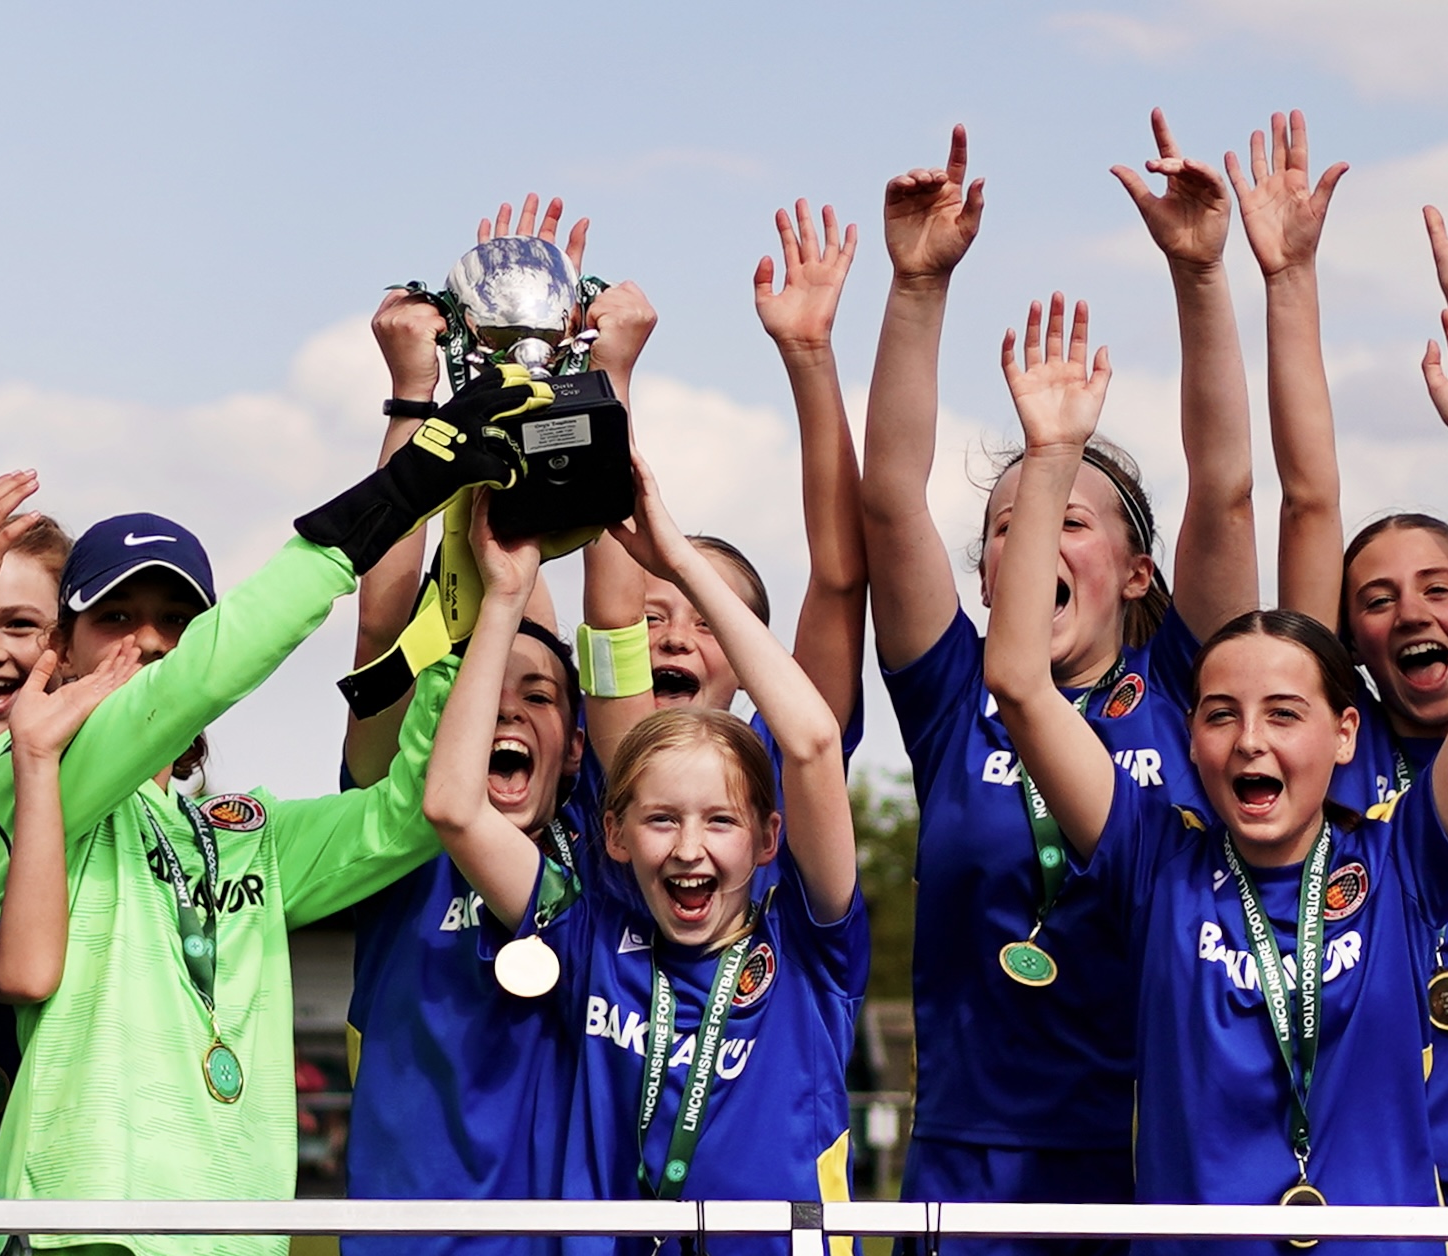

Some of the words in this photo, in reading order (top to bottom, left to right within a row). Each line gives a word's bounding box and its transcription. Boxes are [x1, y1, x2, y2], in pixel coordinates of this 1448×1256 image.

[1237, 874, 1266, 942] FOOTBALL
[1304, 874, 1323, 942] FOOTBALL
[1256, 939, 1290, 1042] LINCOLNSHIRE
[1302, 941, 1317, 1039] ASSOCIATION
[641, 1024, 669, 1130] LINCOLNSHIRE
[656, 971, 671, 1024] FOOTB
[682, 1024, 720, 1132] LINCOLNSHIRE
[710, 954, 742, 1025] FOOTBALL
